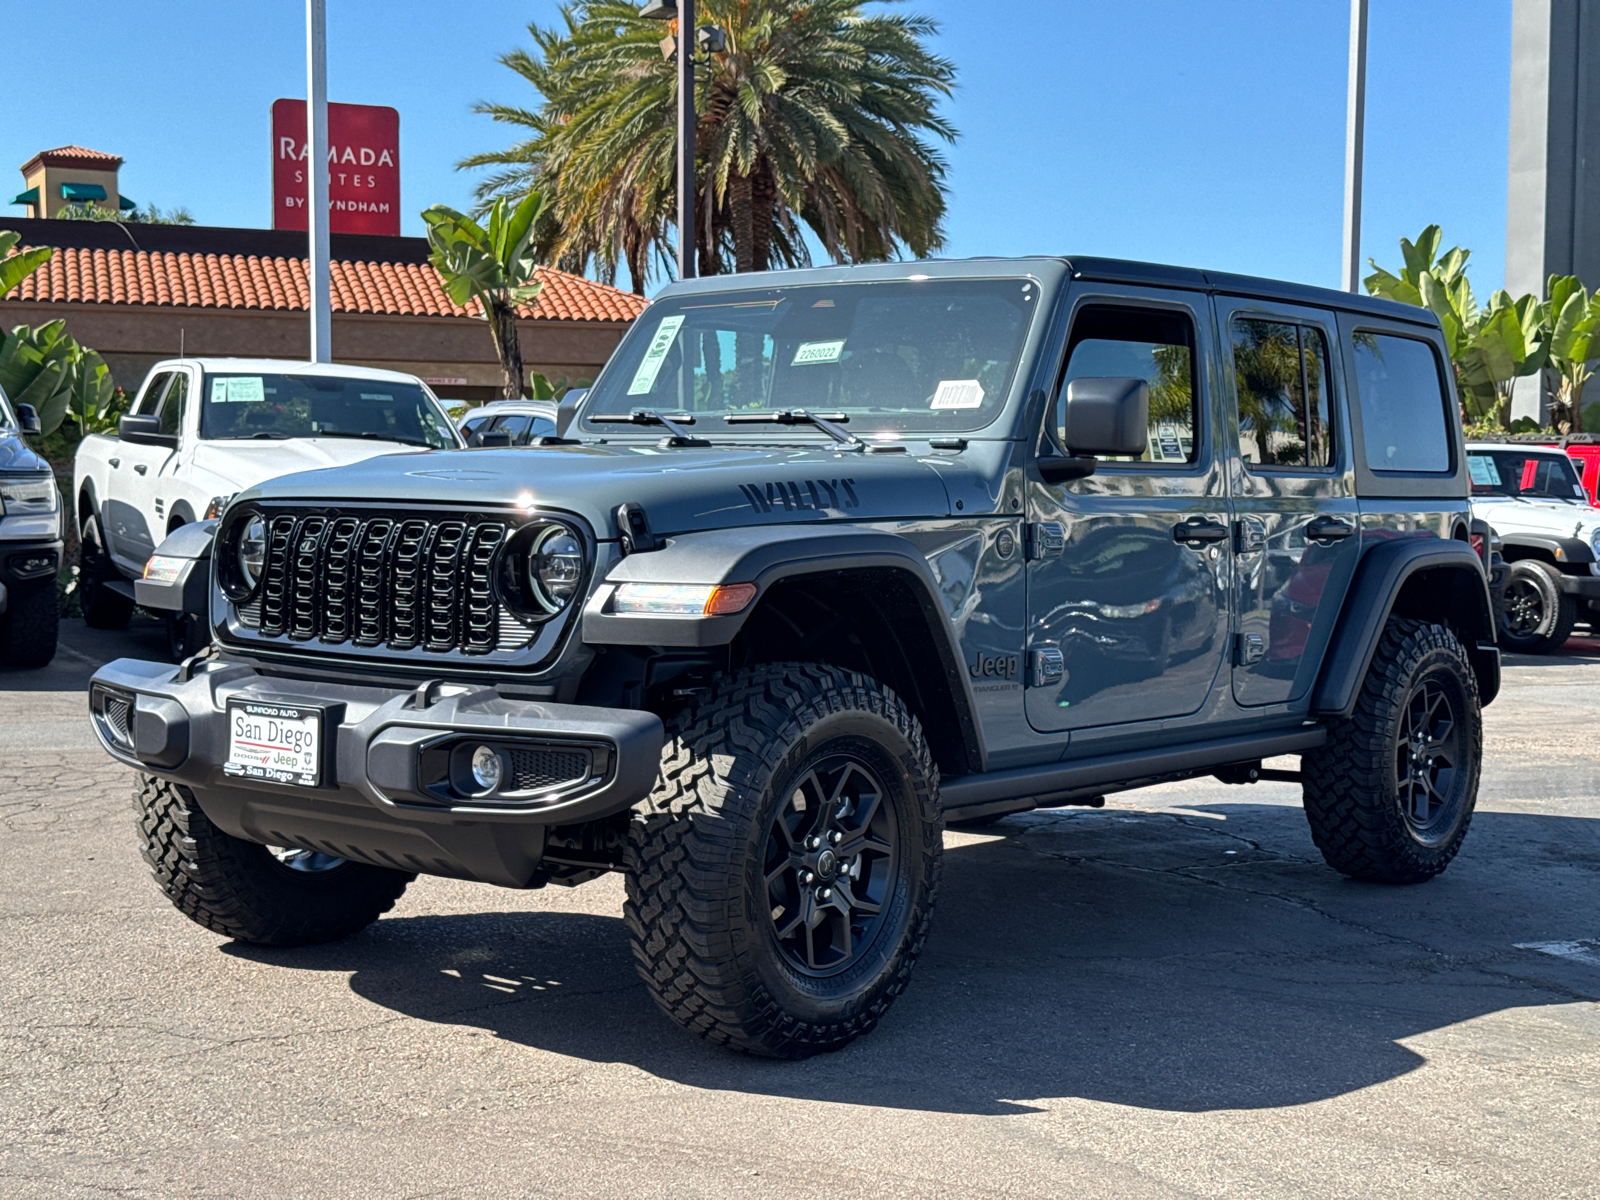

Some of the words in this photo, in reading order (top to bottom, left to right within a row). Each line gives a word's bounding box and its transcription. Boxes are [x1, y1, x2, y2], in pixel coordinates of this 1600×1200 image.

[294, 169, 376, 188] SITES
[285, 196, 305, 208] BY
[328, 199, 390, 213] YNDHAM
[799, 346, 837, 360] 2260022
[738, 478, 860, 514] WILLYS
[969, 651, 1019, 680] Jeep
[246, 705, 278, 716] SUNROAD
[279, 709, 299, 718] AUTO
[235, 716, 262, 741] San
[267, 720, 313, 754] Diego
[273, 751, 298, 769] Jeep
[246, 766, 264, 777] San
[265, 767, 294, 782] Diego
